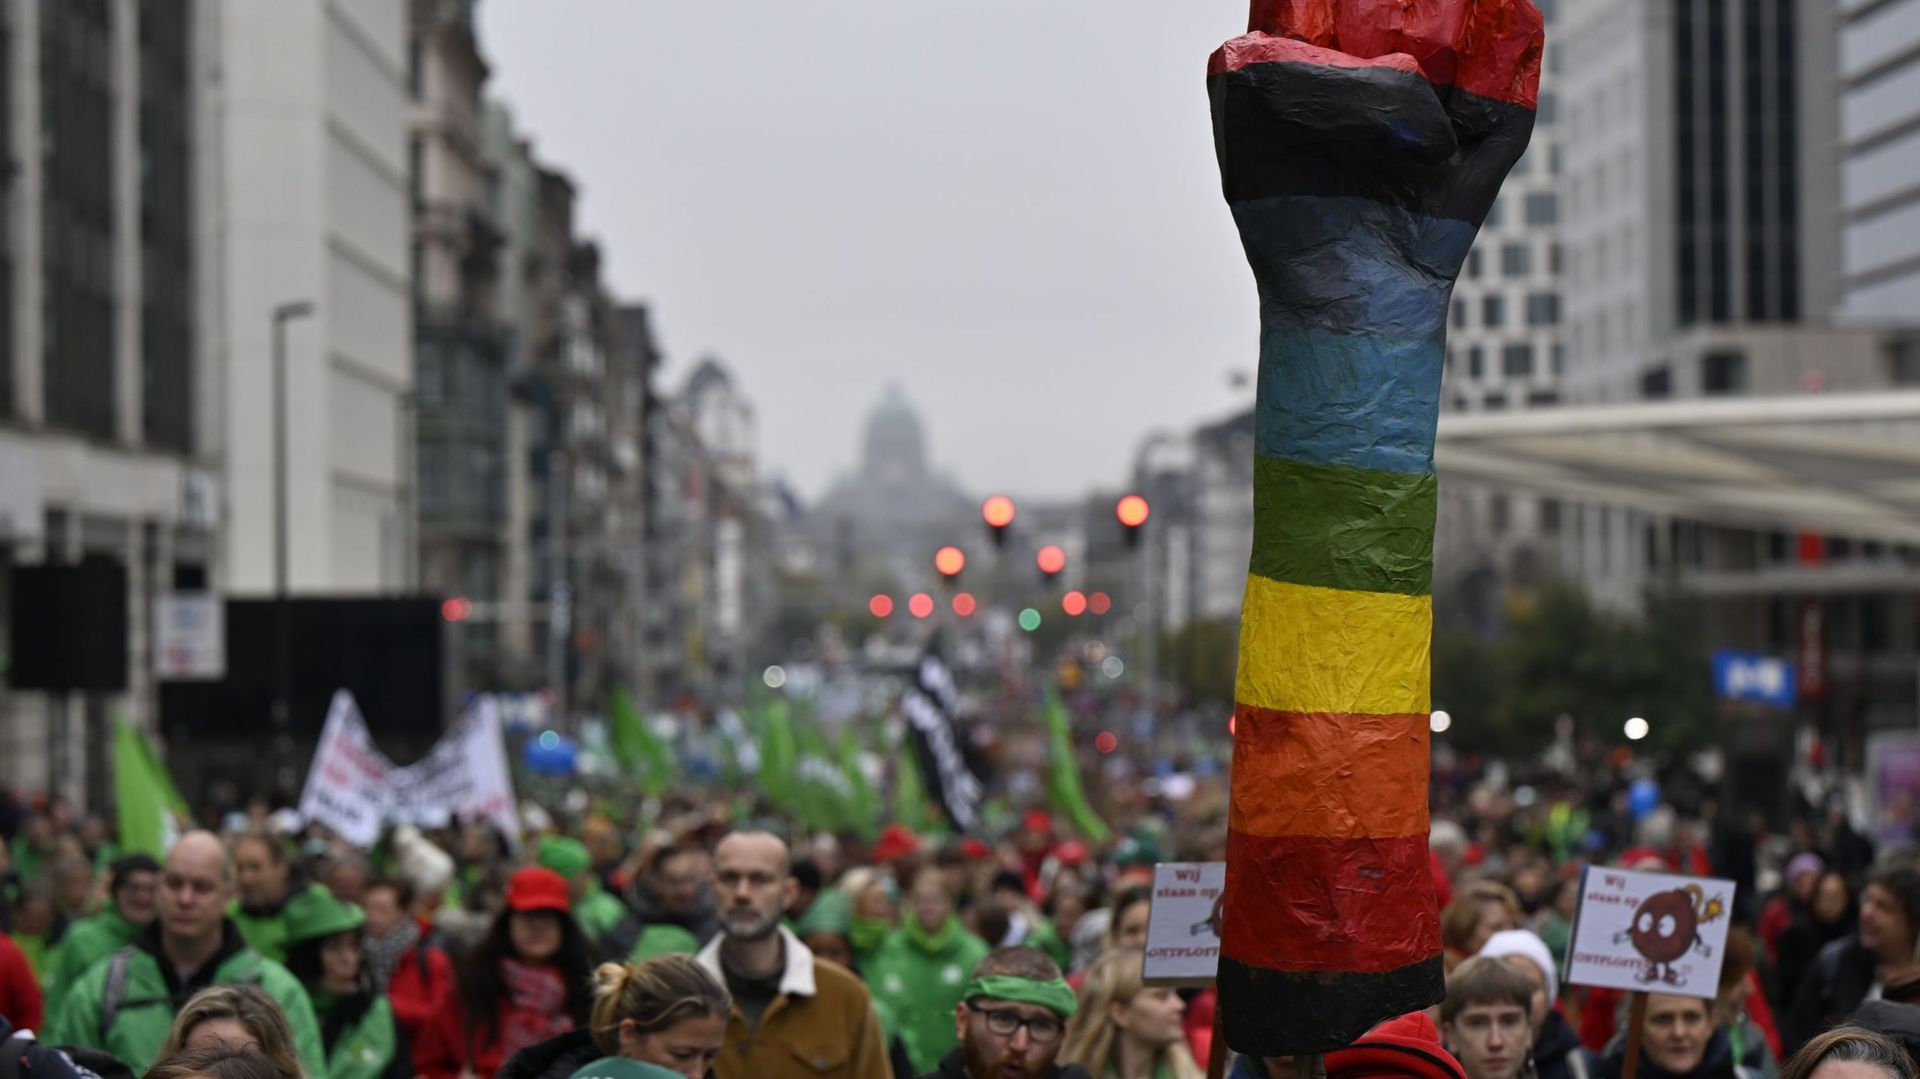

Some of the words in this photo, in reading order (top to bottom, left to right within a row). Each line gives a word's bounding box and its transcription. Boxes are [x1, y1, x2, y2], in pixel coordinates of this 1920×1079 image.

[1175, 869, 1201, 882] Wij
[1604, 873, 1626, 891] Wij
[1157, 887, 1196, 898] staan
[1200, 888, 1219, 899] op
